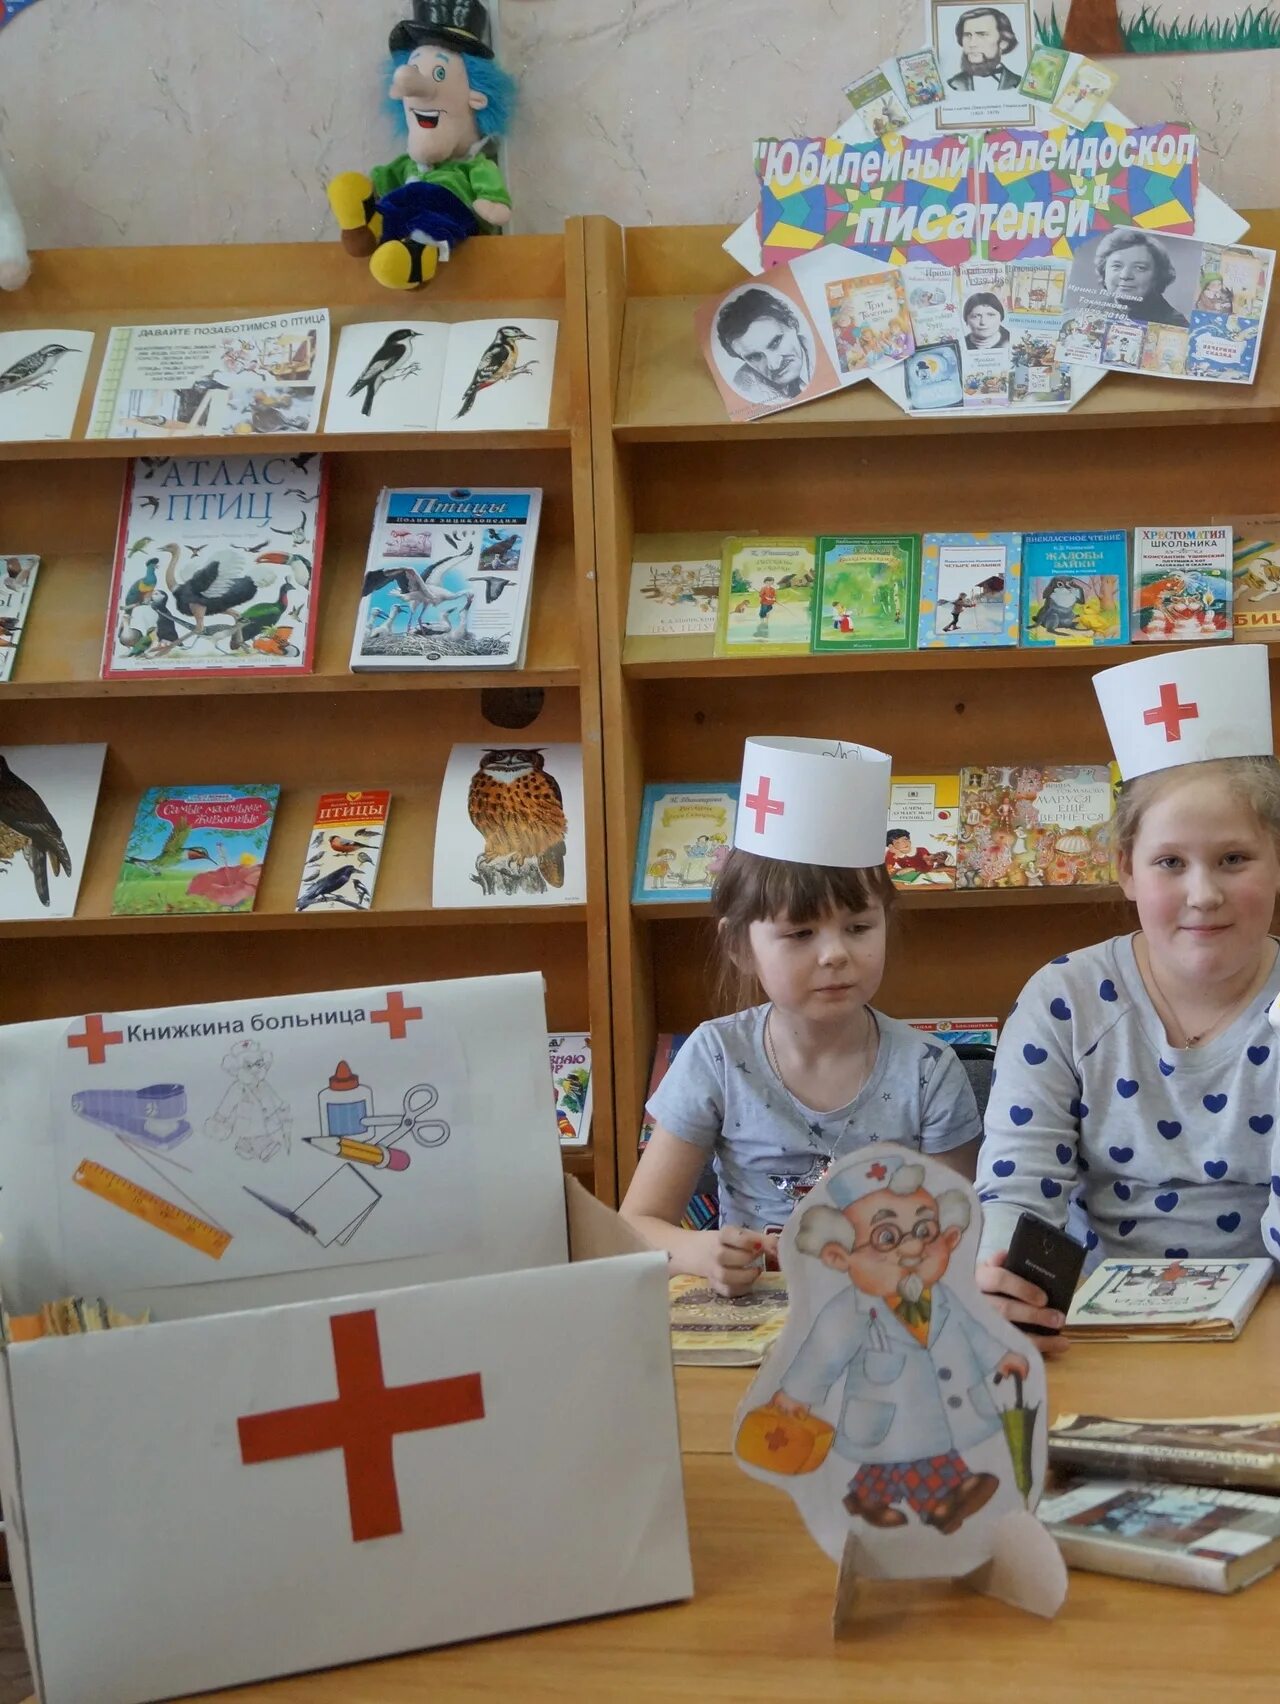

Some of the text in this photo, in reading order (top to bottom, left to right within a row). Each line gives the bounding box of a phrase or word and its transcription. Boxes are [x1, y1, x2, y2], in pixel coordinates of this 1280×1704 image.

[979, 127, 1195, 179] калейдоскоп
[137, 327, 191, 338] ДАВАЙТЕ
[194, 319, 277, 336] ПОЗАБОТИМСЯ
[280, 318, 288, 327] О
[160, 458, 286, 487] АТЛАС
[166, 492, 273, 528] ПТИЦ
[410, 497, 509, 518] Птицы
[1088, 533, 1121, 542] ЧТЕНИЕ
[1142, 530, 1226, 540] ХРЕСТОМАТИЯ
[1150, 539, 1218, 548] ШКОЛЬНИКА
[1038, 795, 1092, 804] МАРУСЯ
[319, 803, 385, 820] ПТИЦЫ
[127, 1008, 366, 1043] Книжкина больница
